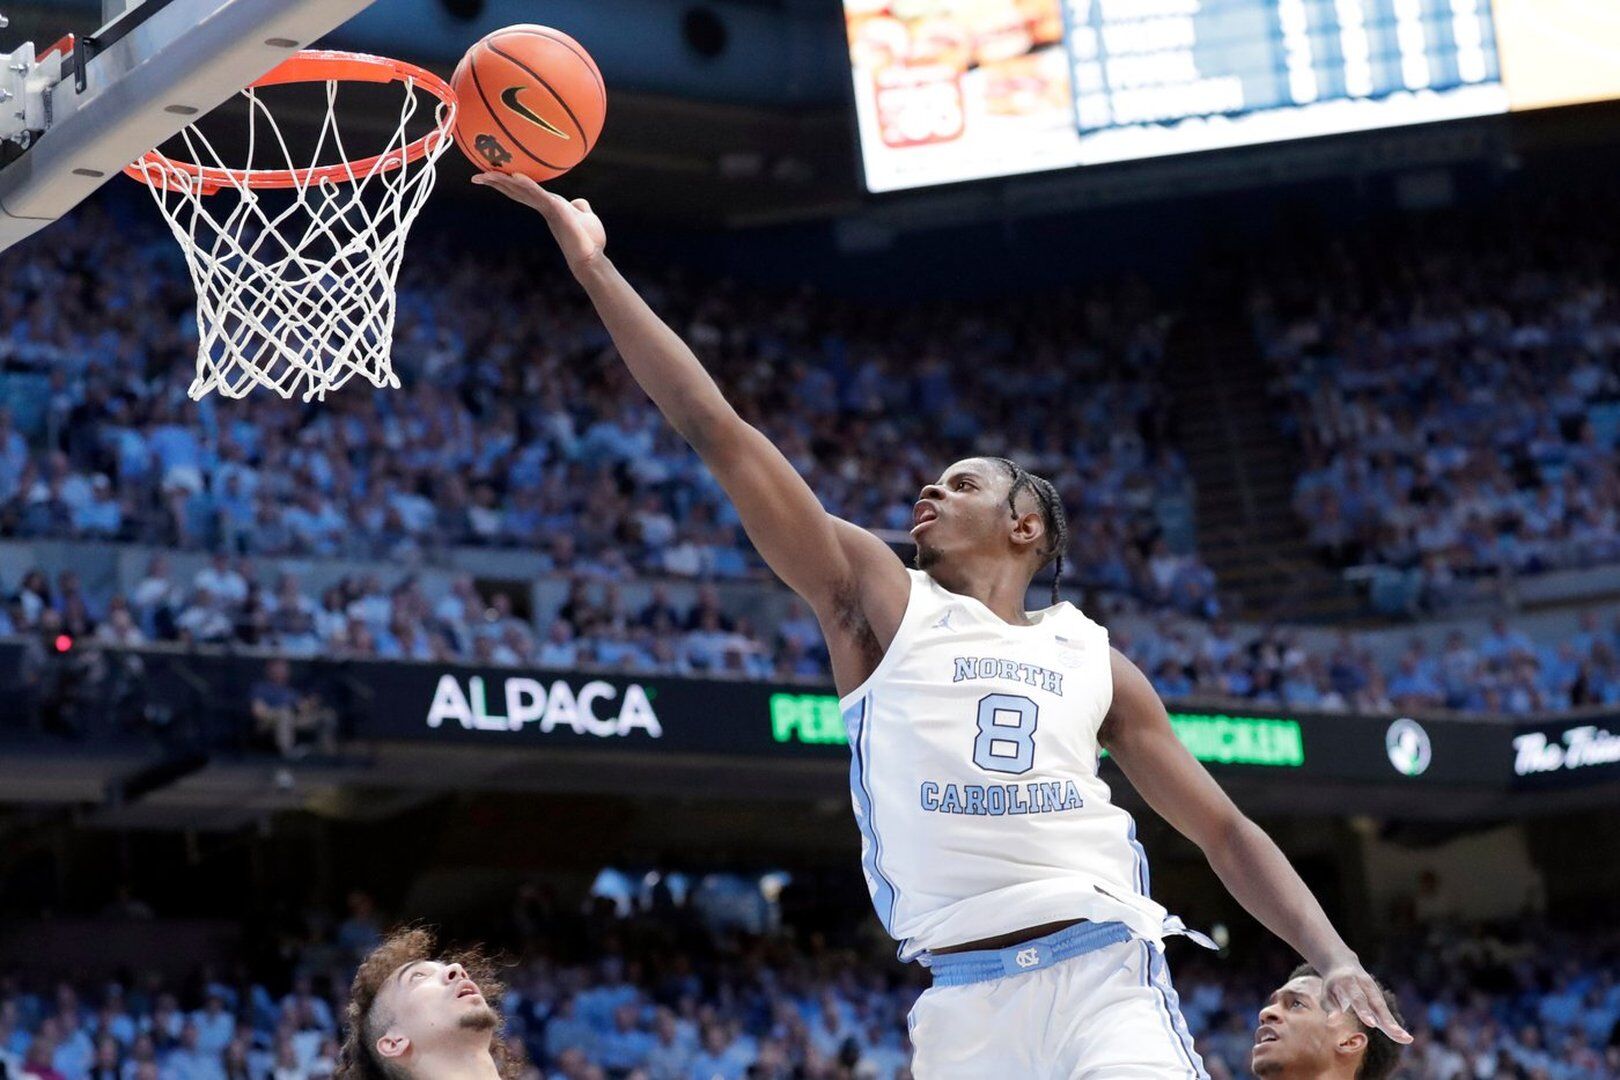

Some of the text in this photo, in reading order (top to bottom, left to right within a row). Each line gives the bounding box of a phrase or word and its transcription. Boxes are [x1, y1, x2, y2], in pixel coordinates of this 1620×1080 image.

[953, 656, 1063, 697] NORTH
[427, 675, 662, 738] ALPACA
[973, 693, 1039, 774] 8
[920, 780, 1084, 816] CAROLINA
